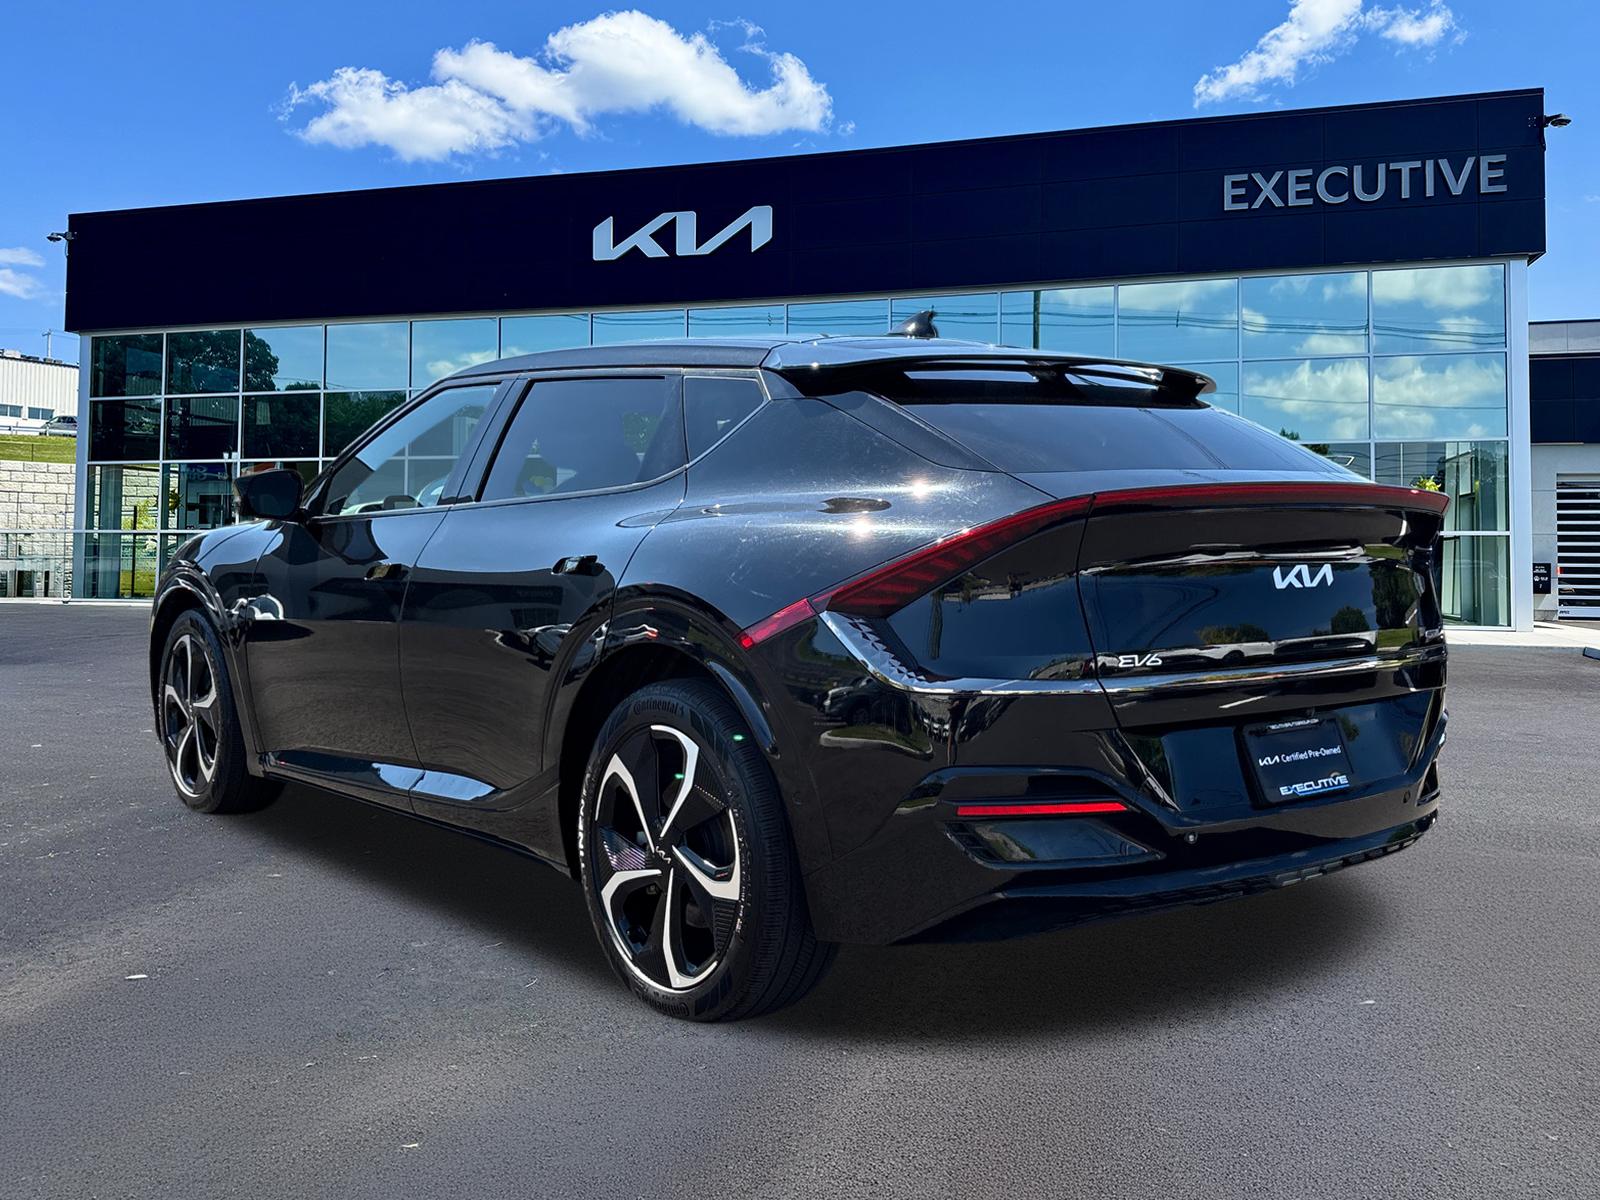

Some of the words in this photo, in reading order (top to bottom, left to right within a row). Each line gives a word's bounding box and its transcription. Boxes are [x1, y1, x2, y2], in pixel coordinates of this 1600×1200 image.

[1224, 154, 1508, 211] EXECUTIVE
[593, 205, 772, 260] KIA
[1272, 564, 1334, 589] KIA
[1118, 654, 1162, 667] EV6
[1259, 755, 1280, 766] KIA
[1281, 750, 1309, 763] Certified
[1308, 745, 1341, 758] Pre-Owned
[1279, 775, 1348, 796] EXECUTIVE
